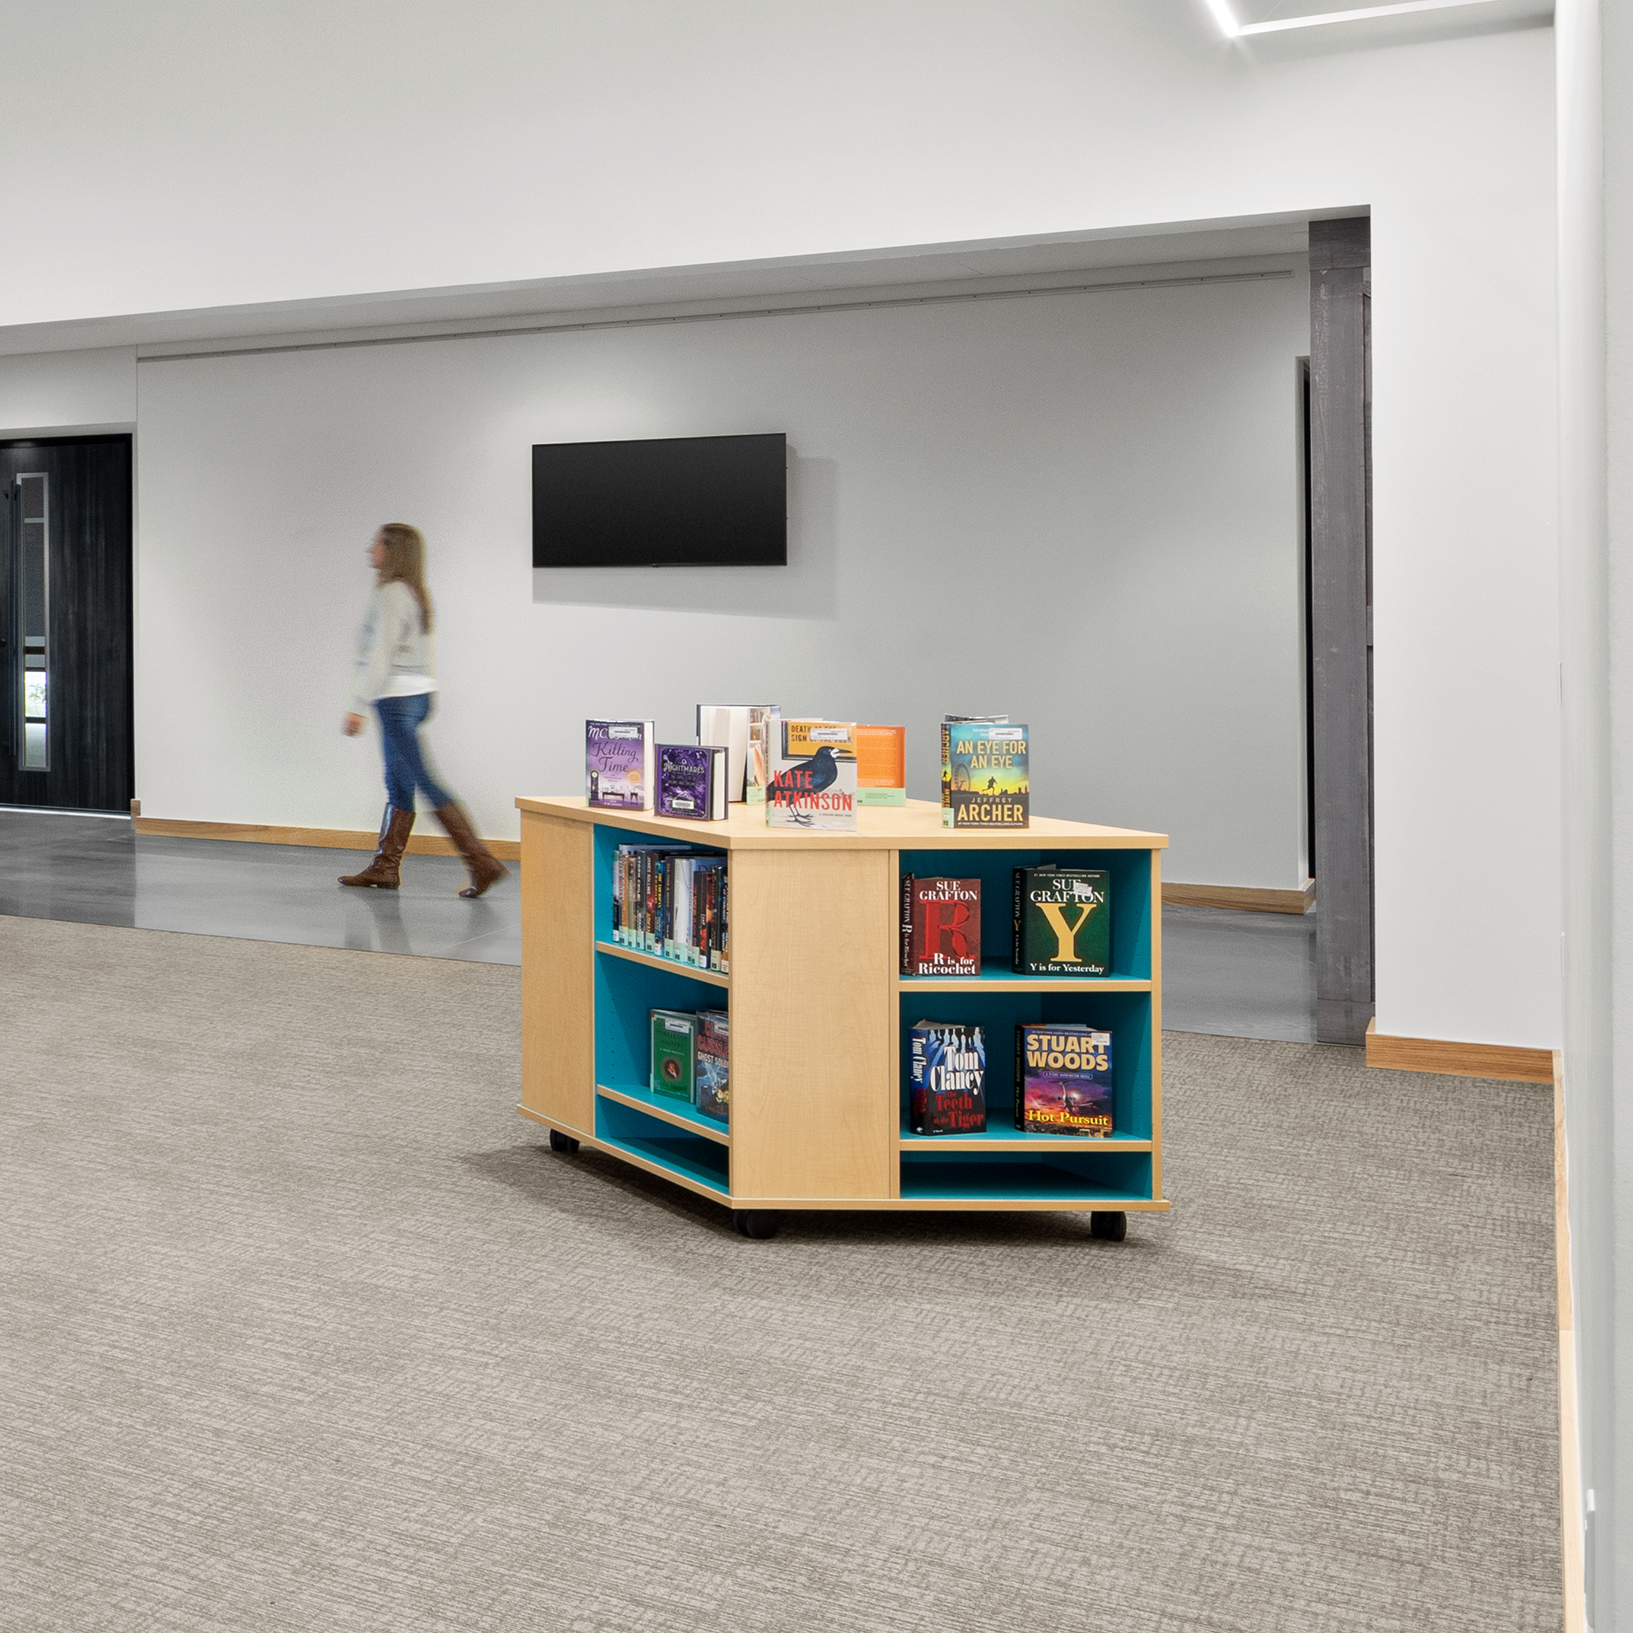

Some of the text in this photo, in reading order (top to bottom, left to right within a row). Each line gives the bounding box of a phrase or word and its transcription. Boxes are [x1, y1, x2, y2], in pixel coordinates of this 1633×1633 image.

[791, 725, 811, 733] DEATH
[791, 734, 807, 742] SIGN
[591, 742, 638, 763] Killing
[957, 740, 1026, 754] AN EYE FOR
[598, 757, 628, 772] Time
[970, 755, 1013, 768] AN EYE
[773, 770, 813, 789] KATE
[773, 790, 853, 811] ATKINSON
[957, 804, 1023, 821] ARCHER
[936, 881, 961, 891] SUE
[919, 890, 978, 900] GRAFTON
[1030, 890, 1105, 903] GRAFTON
[902, 924, 913, 933] R
[919, 900, 976, 959] R
[1035, 903, 1097, 962] Y
[934, 953, 974, 965] R is for
[919, 963, 976, 974] Ricochet
[1030, 963, 1105, 975] Y is for Yesterday
[912, 1037, 926, 1055] Tom
[944, 1045, 979, 1071] Tom
[1027, 1051, 1108, 1071] WOODS
[911, 1056, 927, 1083] Clancy
[930, 1066, 984, 1095] Clancy
[936, 1092, 972, 1111] Teeth
[949, 1111, 984, 1129] Tiger
[1028, 1110, 1108, 1125] Hot Pursuit
